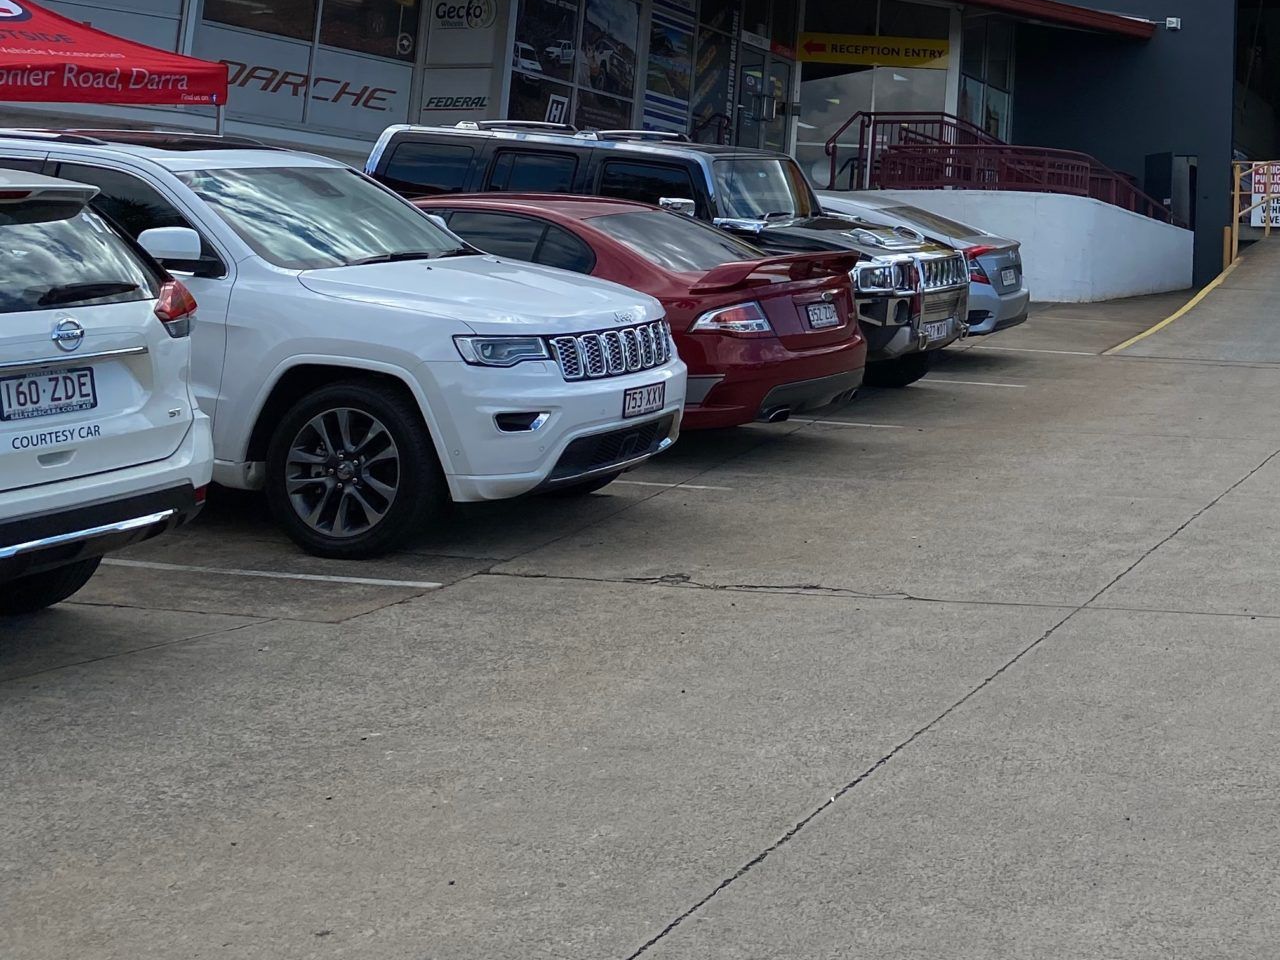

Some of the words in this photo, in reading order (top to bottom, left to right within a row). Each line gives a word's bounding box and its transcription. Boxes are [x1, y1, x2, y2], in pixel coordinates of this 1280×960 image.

[831, 44, 899, 57] RECEPTION
[904, 48, 944, 58] ENTRY
[63, 63, 122, 91] Road,
[129, 67, 188, 90] Darra
[426, 97, 488, 107] FEDERAL
[1261, 216, 1280, 224] GVE
[614, 312, 632, 323] Jeep
[169, 408, 182, 418] ST
[12, 429, 75, 449] COURTESY
[78, 425, 100, 439] CAR
